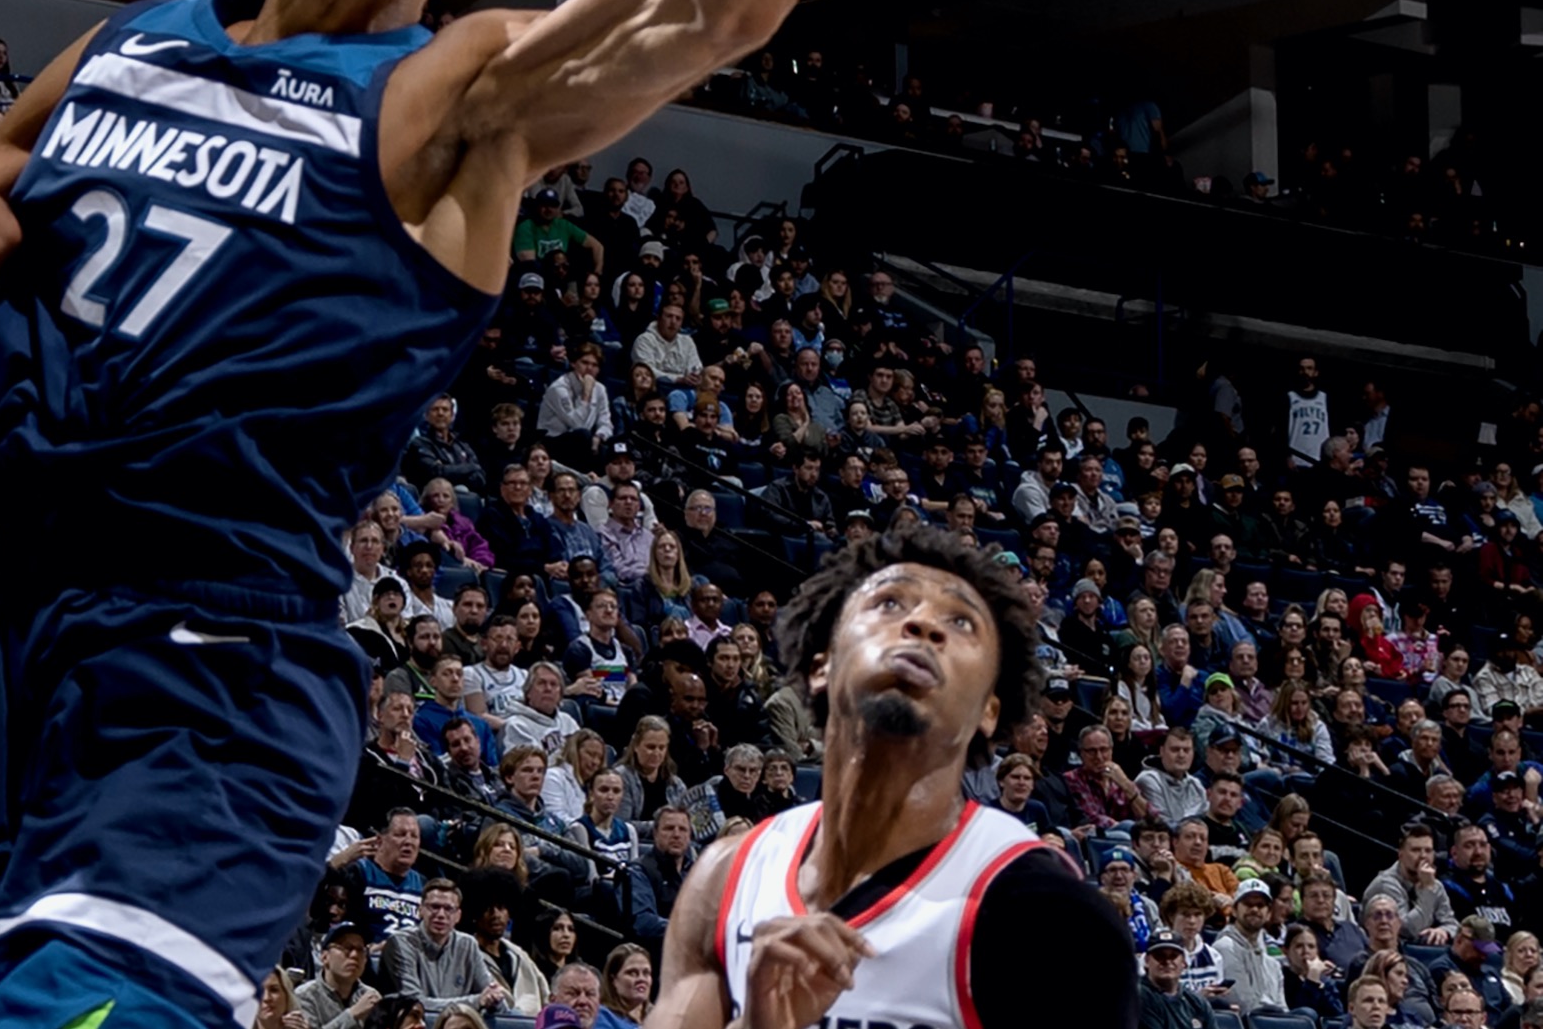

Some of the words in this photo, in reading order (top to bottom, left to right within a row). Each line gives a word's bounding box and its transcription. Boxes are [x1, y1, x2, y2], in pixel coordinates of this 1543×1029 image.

[40, 99, 305, 226] MINNESOTA
[58, 183, 235, 340] 27
[1302, 421, 1321, 436] 27
